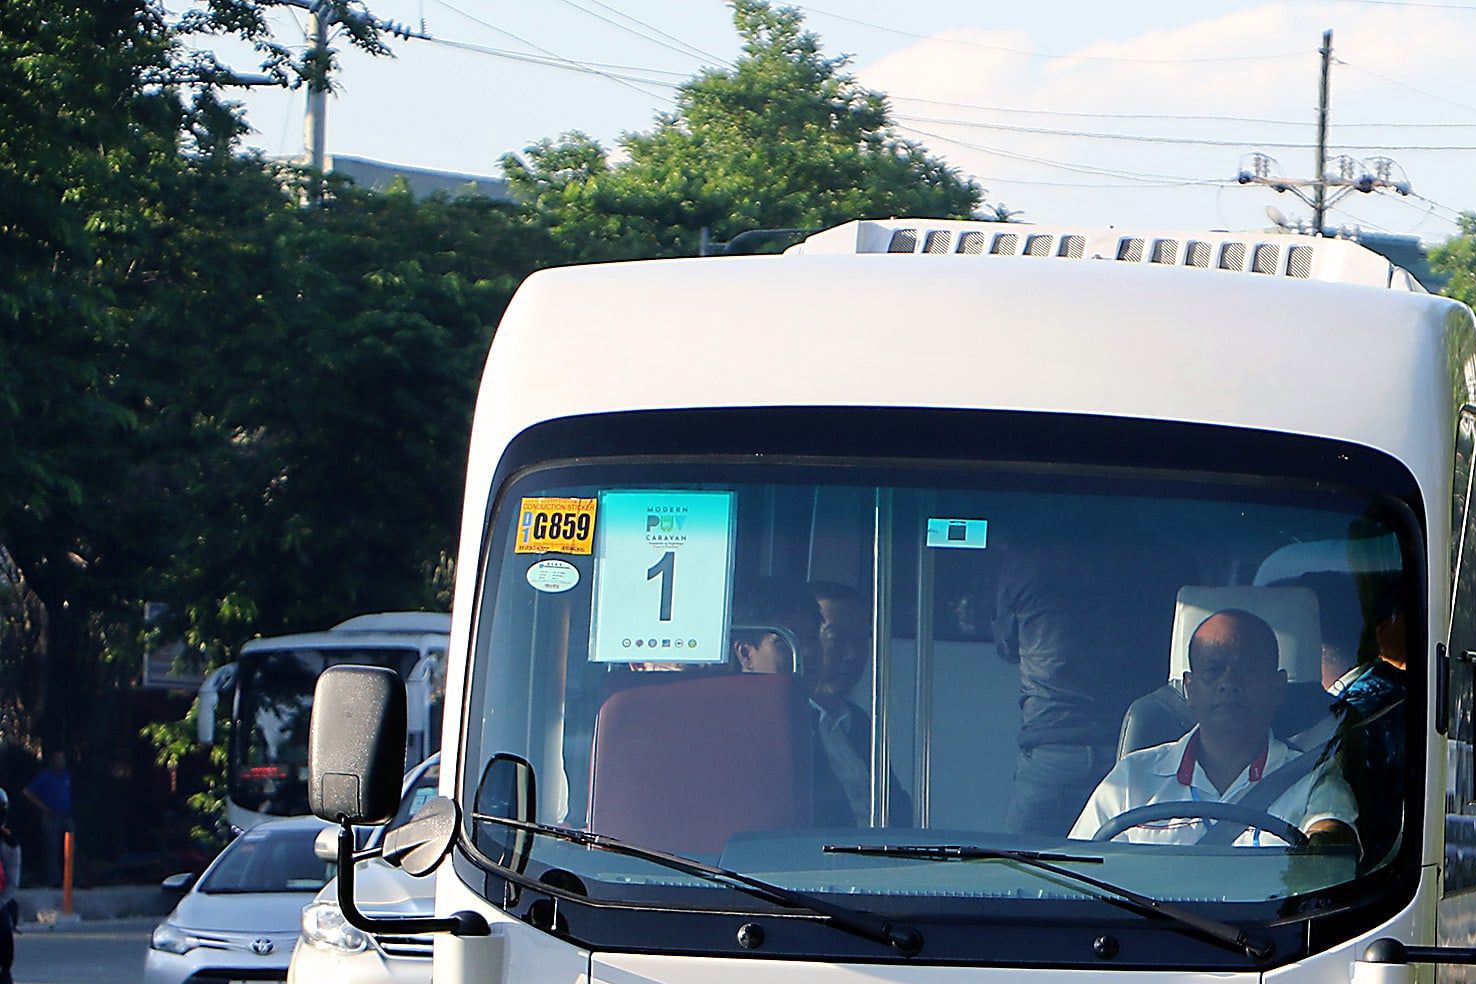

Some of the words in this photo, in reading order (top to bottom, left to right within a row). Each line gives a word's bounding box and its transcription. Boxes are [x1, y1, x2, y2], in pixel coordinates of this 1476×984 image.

[568, 503, 595, 511] STICKER
[533, 512, 591, 541] G859
[646, 515, 687, 532] PUV
[646, 551, 676, 621] 1
